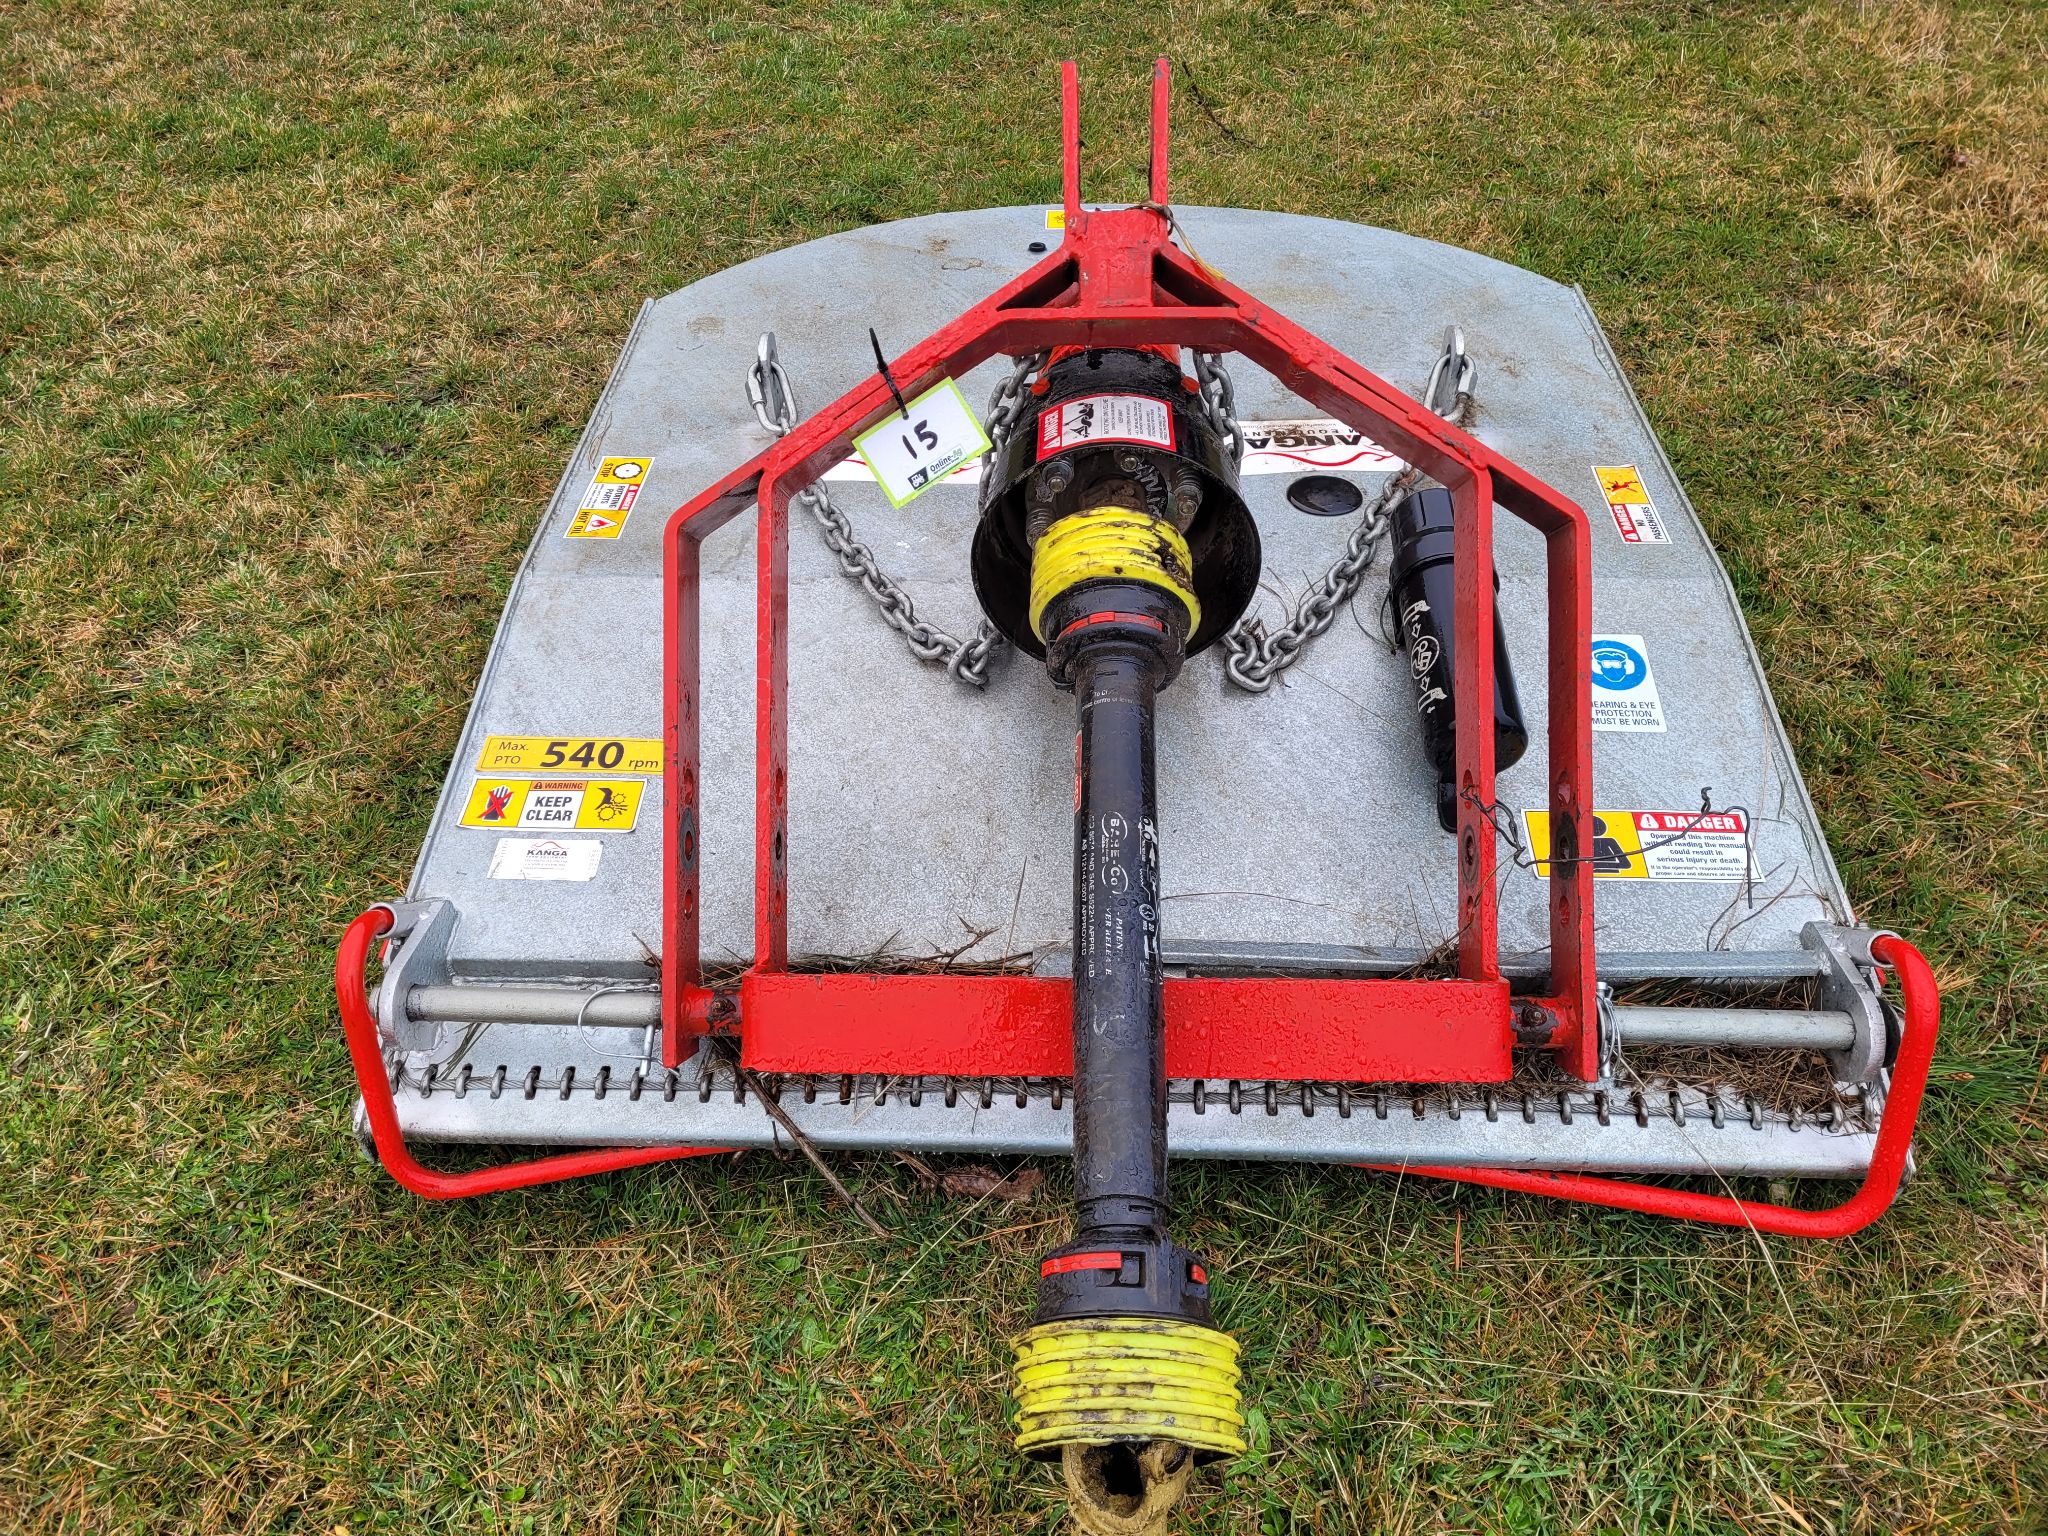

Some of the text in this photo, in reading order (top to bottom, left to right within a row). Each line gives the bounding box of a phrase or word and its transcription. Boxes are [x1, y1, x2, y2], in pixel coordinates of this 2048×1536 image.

[902, 419, 938, 460] 15
[1244, 435, 1380, 449] ANGA
[930, 448, 963, 472] Online-Ag
[600, 463, 613, 478] STOP
[600, 489, 614, 504] PARTS
[609, 486, 626, 508] ROTATING
[571, 512, 590, 534] HOT OIL
[1614, 504, 1633, 531] DANGER
[1641, 506, 1664, 540] PASSENGERS
[1596, 710, 1652, 718] PROTECTION
[1620, 718, 1630, 726] BE
[1632, 718, 1660, 726] WORN
[494, 755, 520, 764] PTO
[498, 742, 659, 770] Max. 540 rpm
[544, 782, 582, 790] WARNING
[534, 796, 572, 808] KEEP
[526, 809, 573, 822] CLEAR
[1664, 815, 1737, 830] DANGER
[1686, 856, 1708, 864] injury
